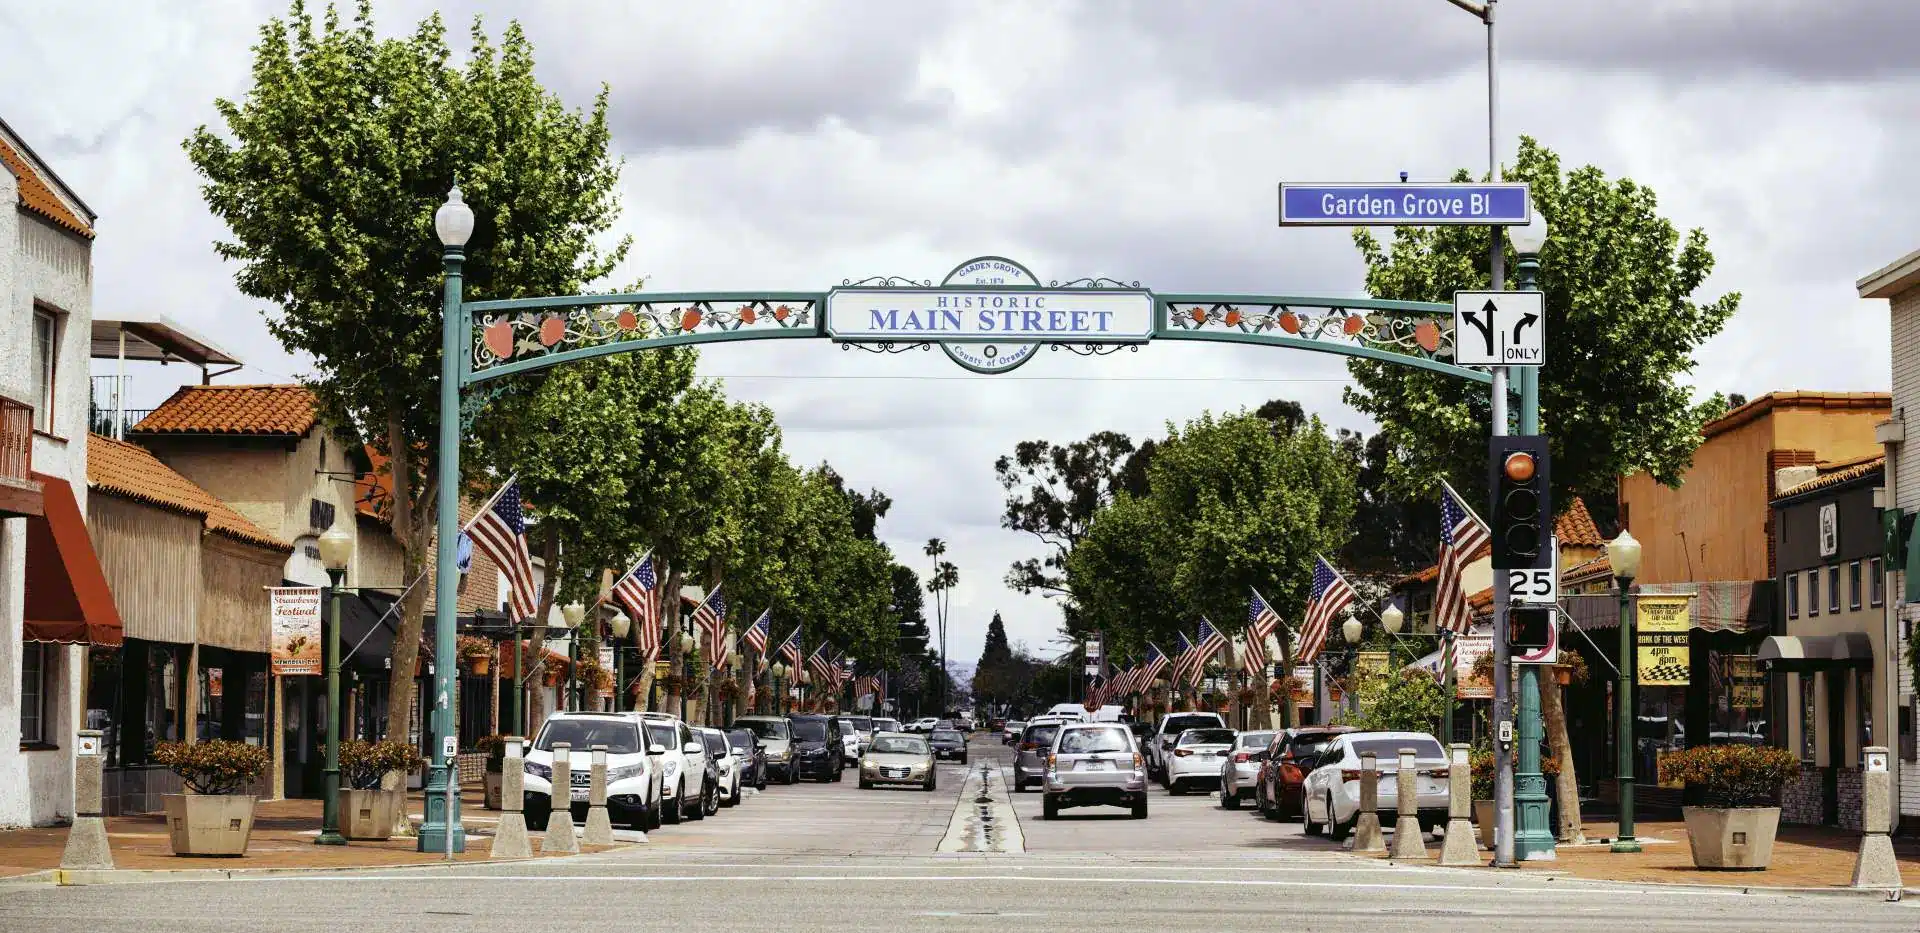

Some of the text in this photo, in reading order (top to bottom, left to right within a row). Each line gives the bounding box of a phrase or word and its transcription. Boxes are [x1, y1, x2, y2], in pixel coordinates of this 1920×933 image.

[1321, 193, 1490, 216] Garden Grove Bl
[959, 262, 1023, 278] GARDEN GROVE
[937, 296, 1045, 308] HISTORIC
[868, 309, 1114, 332] MAIN STREET
[954, 344, 1028, 367] County of Orange
[1506, 347, 1539, 359] ONLY
[1509, 570, 1552, 596] 25
[274, 596, 319, 605] Strawberry
[274, 605, 317, 616] Festival
[1638, 635, 1688, 644] BANK OF THE WEST
[1650, 647, 1669, 657] 4pm
[1659, 656, 1677, 666] 8pm
